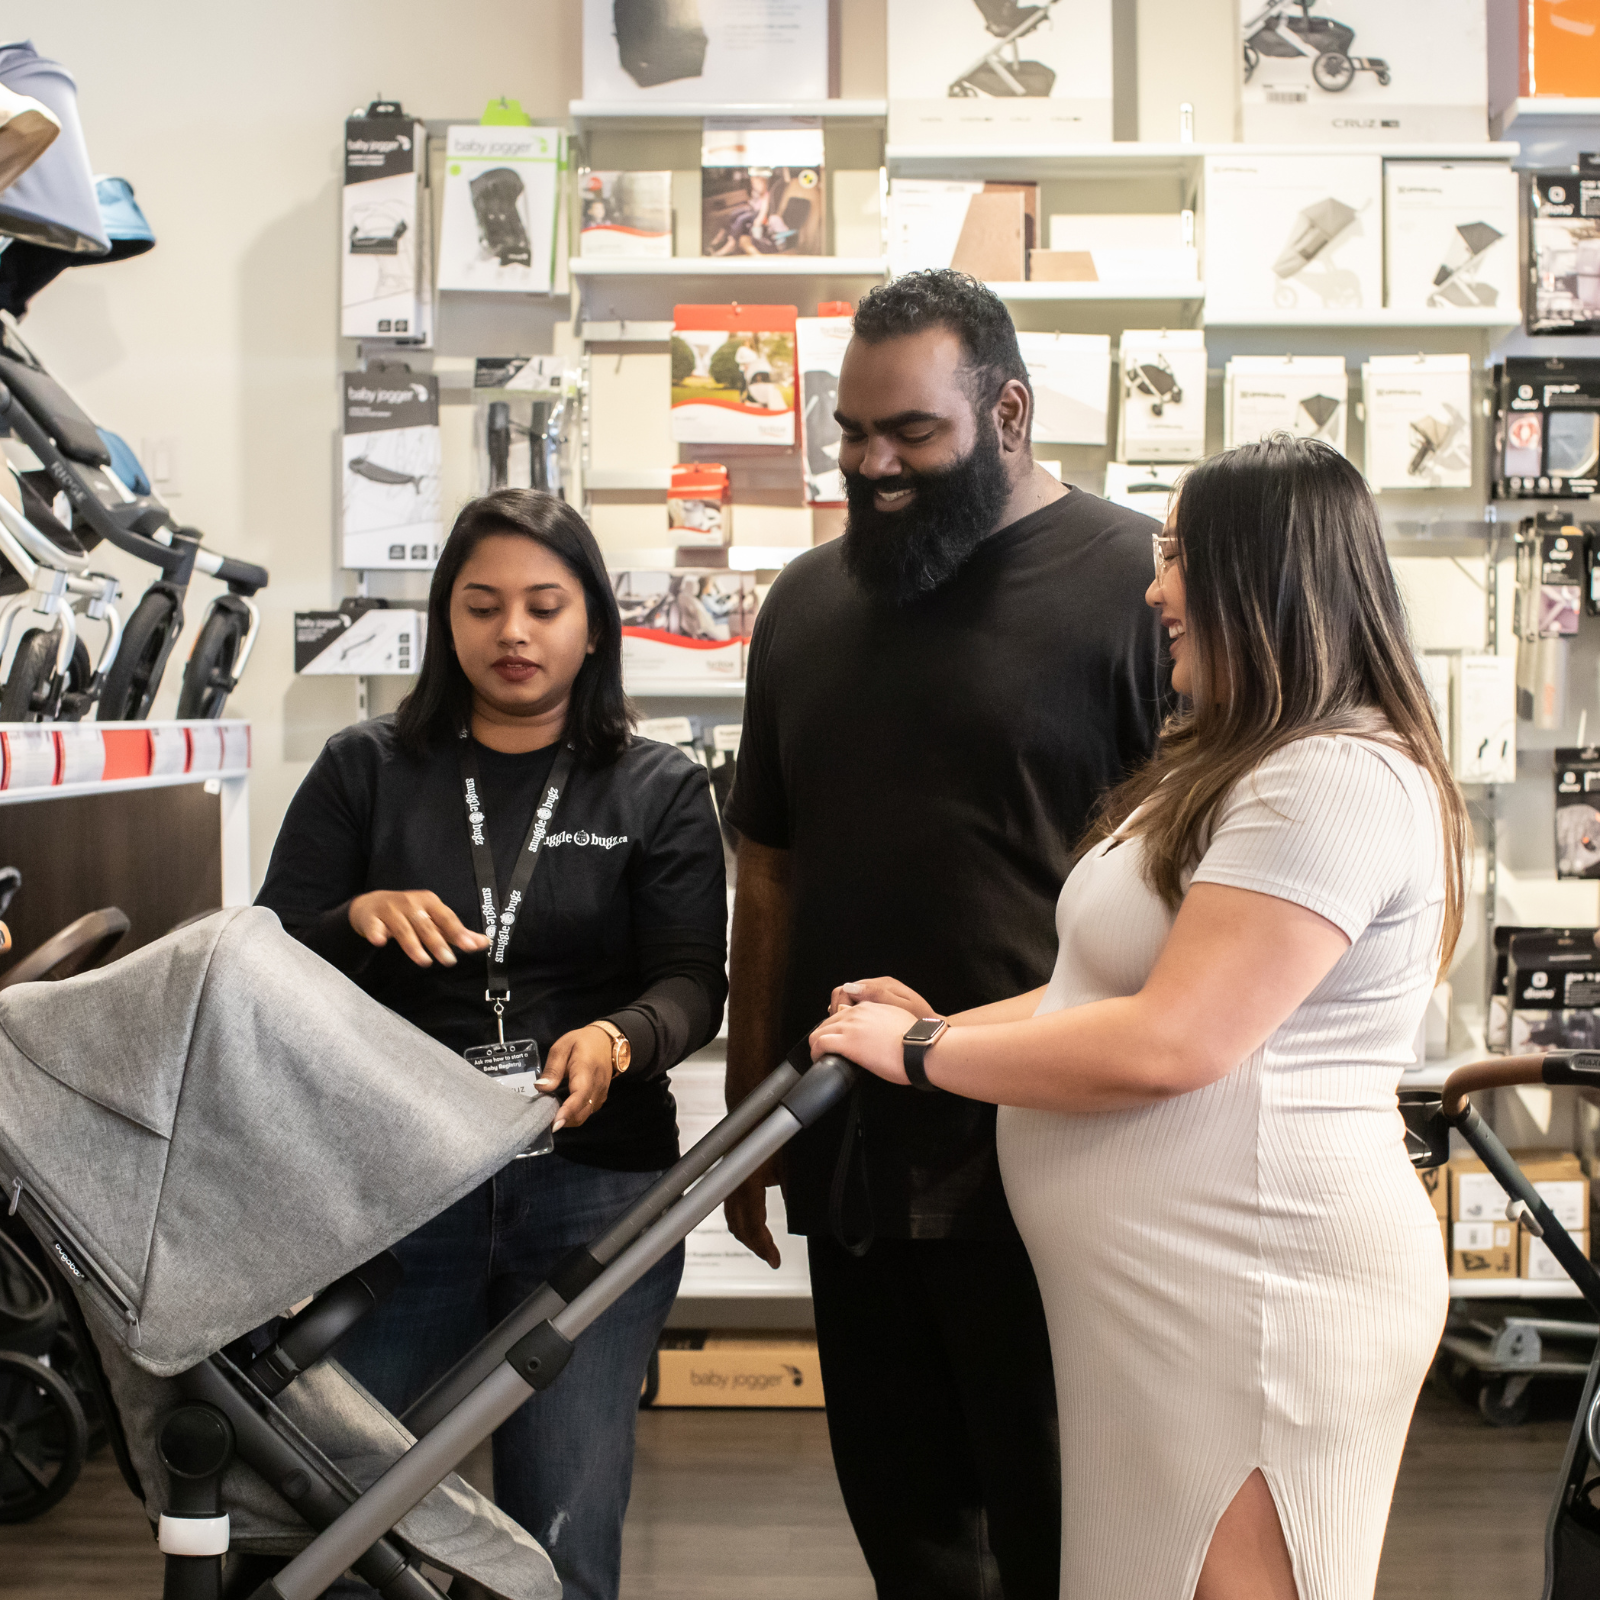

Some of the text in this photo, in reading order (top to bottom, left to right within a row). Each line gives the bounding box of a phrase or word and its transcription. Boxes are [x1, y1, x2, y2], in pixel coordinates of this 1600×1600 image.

[347, 138, 400, 153] baby jogger
[455, 138, 532, 156] baby jogger
[347, 386, 414, 405] baby jogger
[465, 777, 484, 846] snuggle bugz
[528, 786, 559, 853] snuggle bugz
[481, 887, 497, 926] snuggle
[495, 889, 522, 963] snuggle bugz
[689, 1367, 784, 1391] baby jogger
